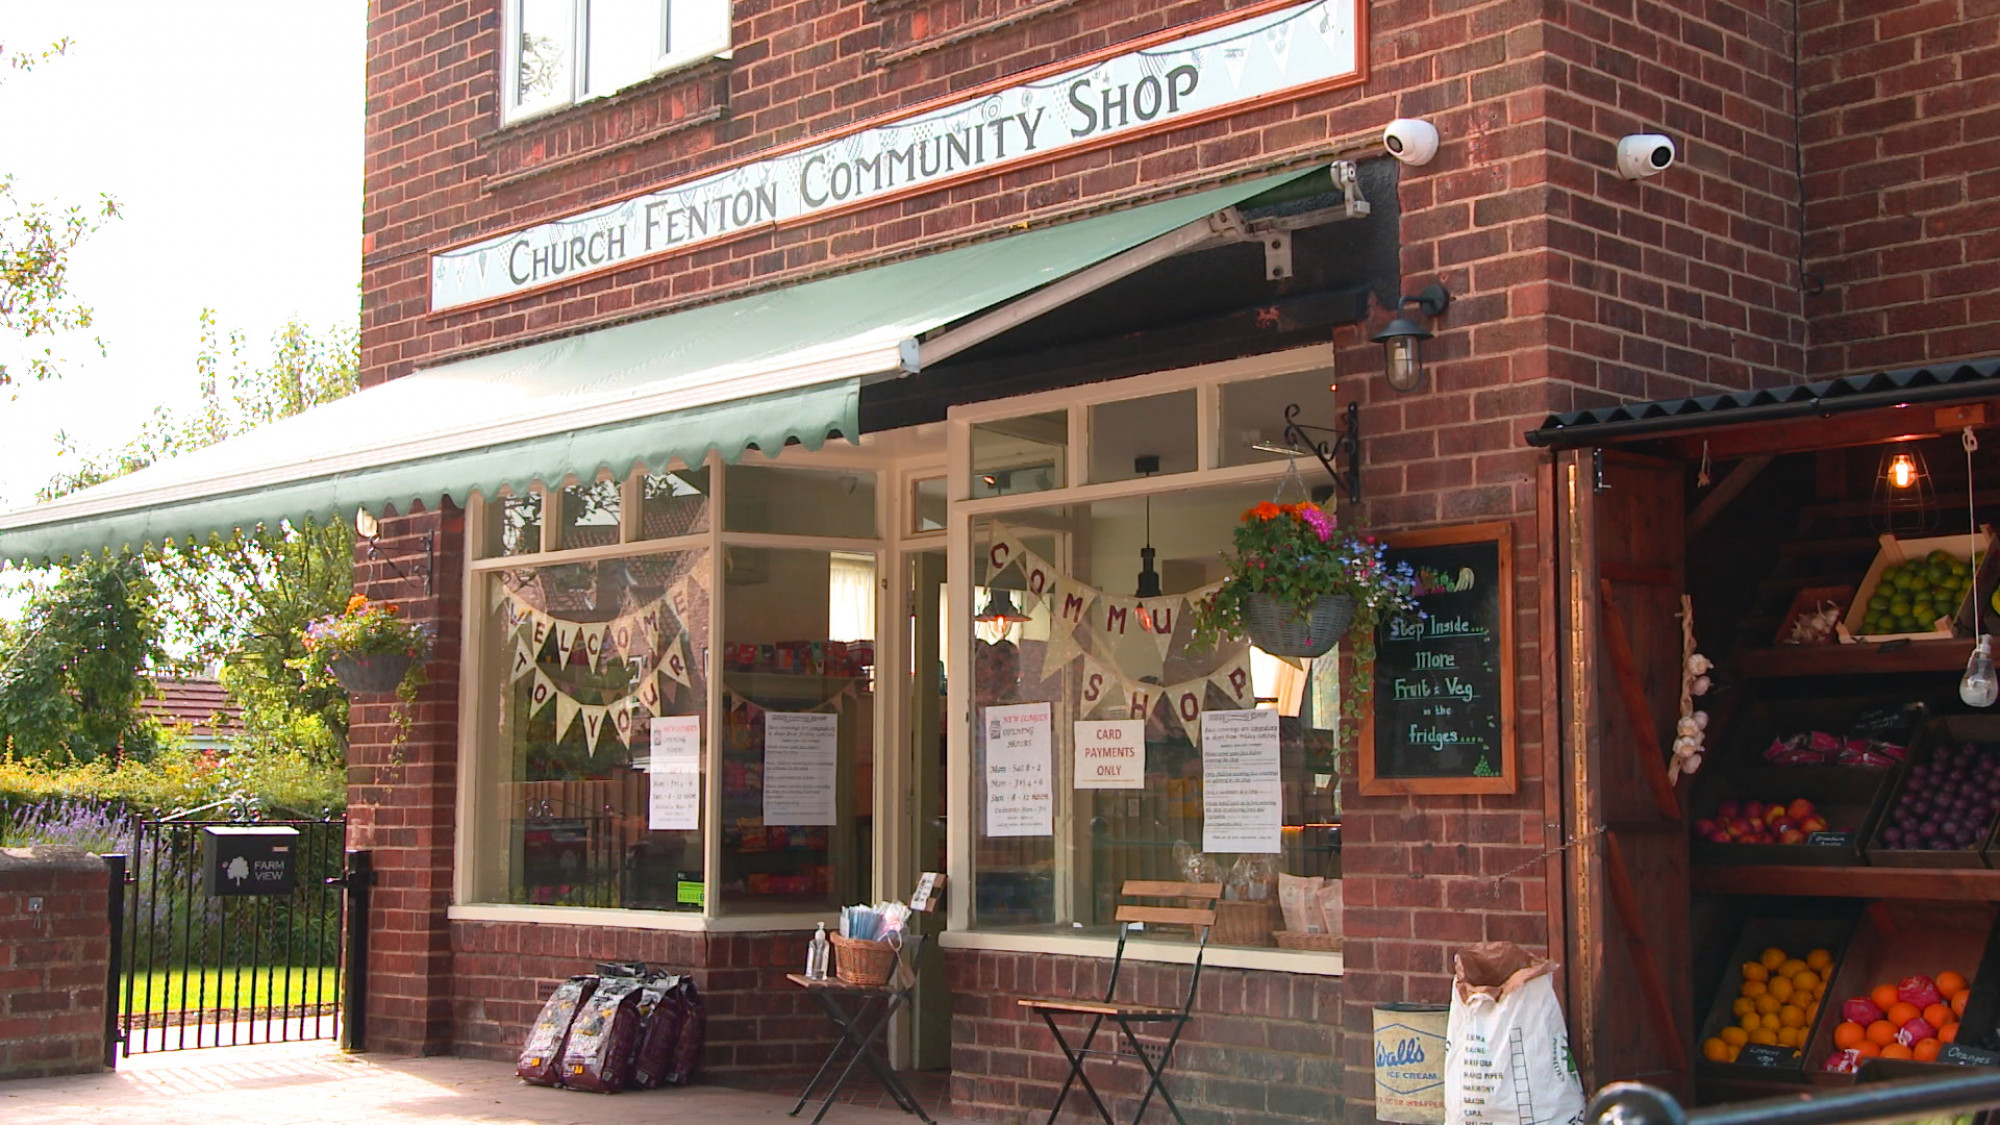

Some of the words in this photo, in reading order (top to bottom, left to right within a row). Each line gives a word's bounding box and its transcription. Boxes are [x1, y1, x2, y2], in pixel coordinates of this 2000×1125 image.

[508, 224, 627, 285] CHURCH
[644, 182, 778, 253] FENTON
[800, 106, 1047, 208] COMMUNITY
[1067, 64, 1200, 138] SHOP
[509, 590, 686, 656] WELCOME
[1084, 666, 1246, 723] SHOP
[1394, 678, 1431, 699] Fruit
[1444, 676, 1473, 702] Veg
[1096, 728, 1122, 740] CARD
[1084, 747, 1135, 758] PAYMENTS
[1096, 765, 1122, 776] ONLY
[254, 860, 285, 871] FARM
[254, 871, 284, 880] VIEW
[1375, 1036, 1425, 1067] Wall's
[1386, 1071, 1401, 1079] ICE
[1402, 1072, 1438, 1080] CREAM
